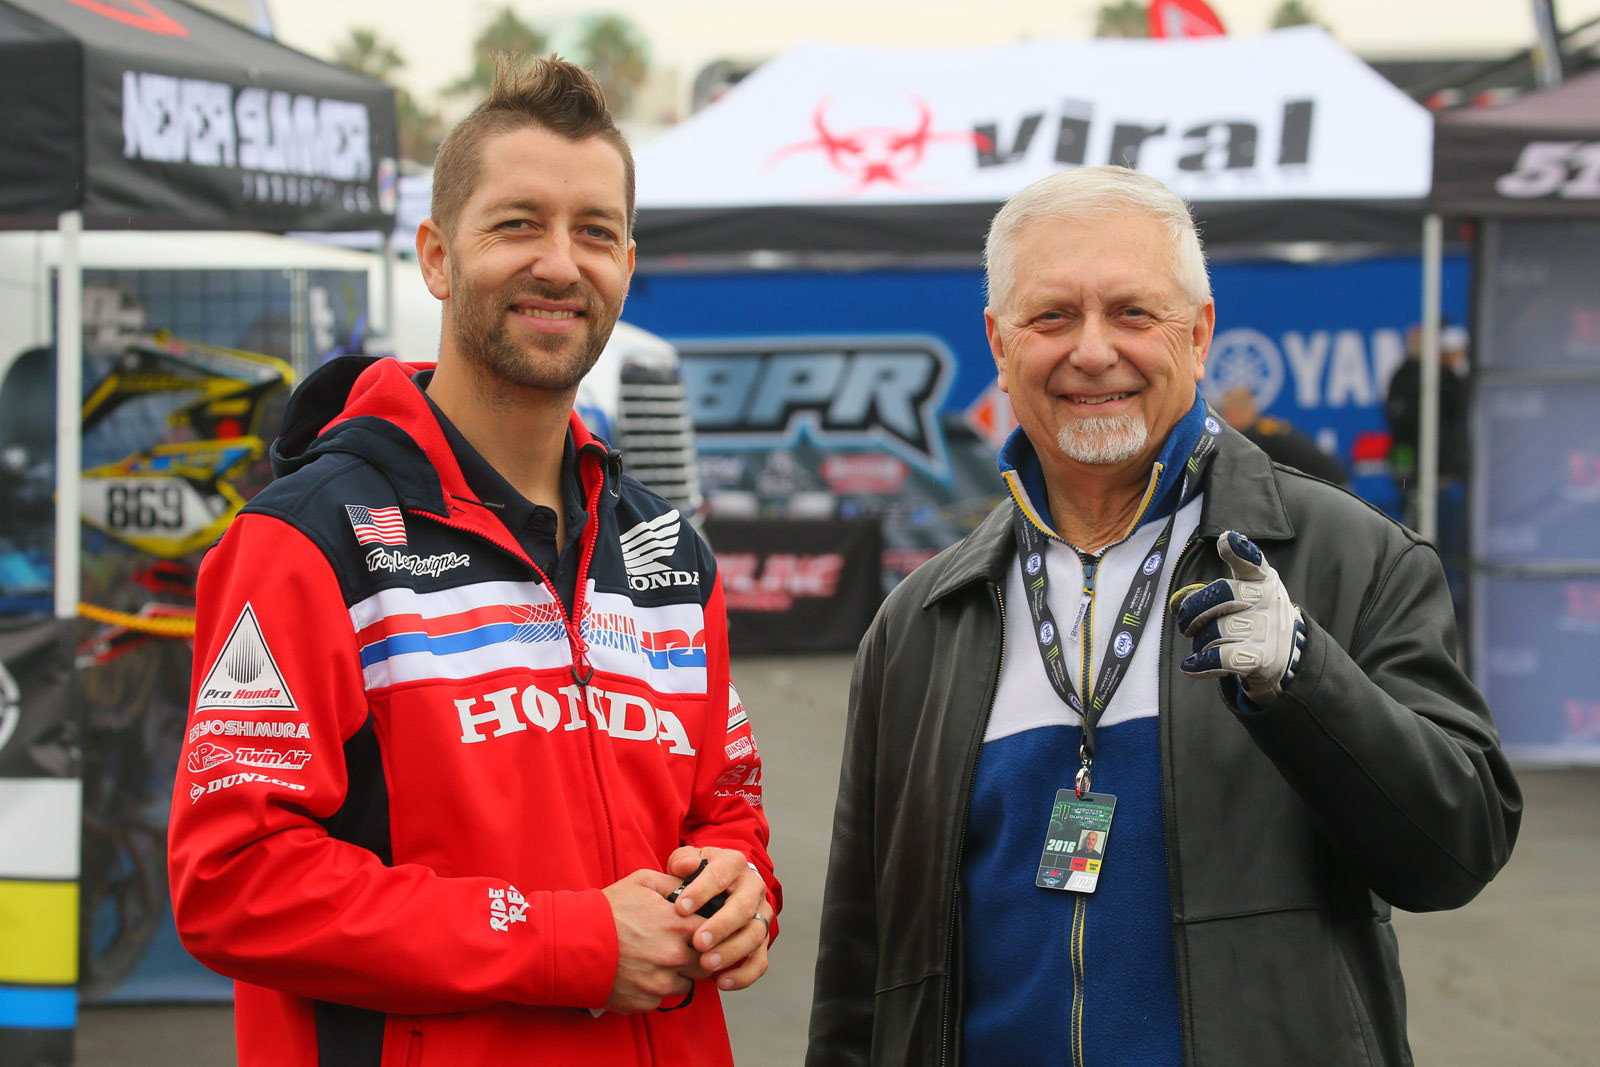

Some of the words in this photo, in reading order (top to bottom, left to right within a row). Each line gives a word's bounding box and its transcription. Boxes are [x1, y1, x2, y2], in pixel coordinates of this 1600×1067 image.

[972, 98, 1316, 168] viral
[681, 353, 937, 446] BPR
[107, 483, 184, 530] 869
[204, 689, 232, 699] Pro
[233, 688, 280, 699] Honda
[199, 719, 310, 739] YOSHIMURA
[454, 684, 696, 756] HONDA
[206, 773, 305, 794] DUNLOP
[1046, 838, 1077, 853] 2016
[488, 888, 510, 932] RIDE
